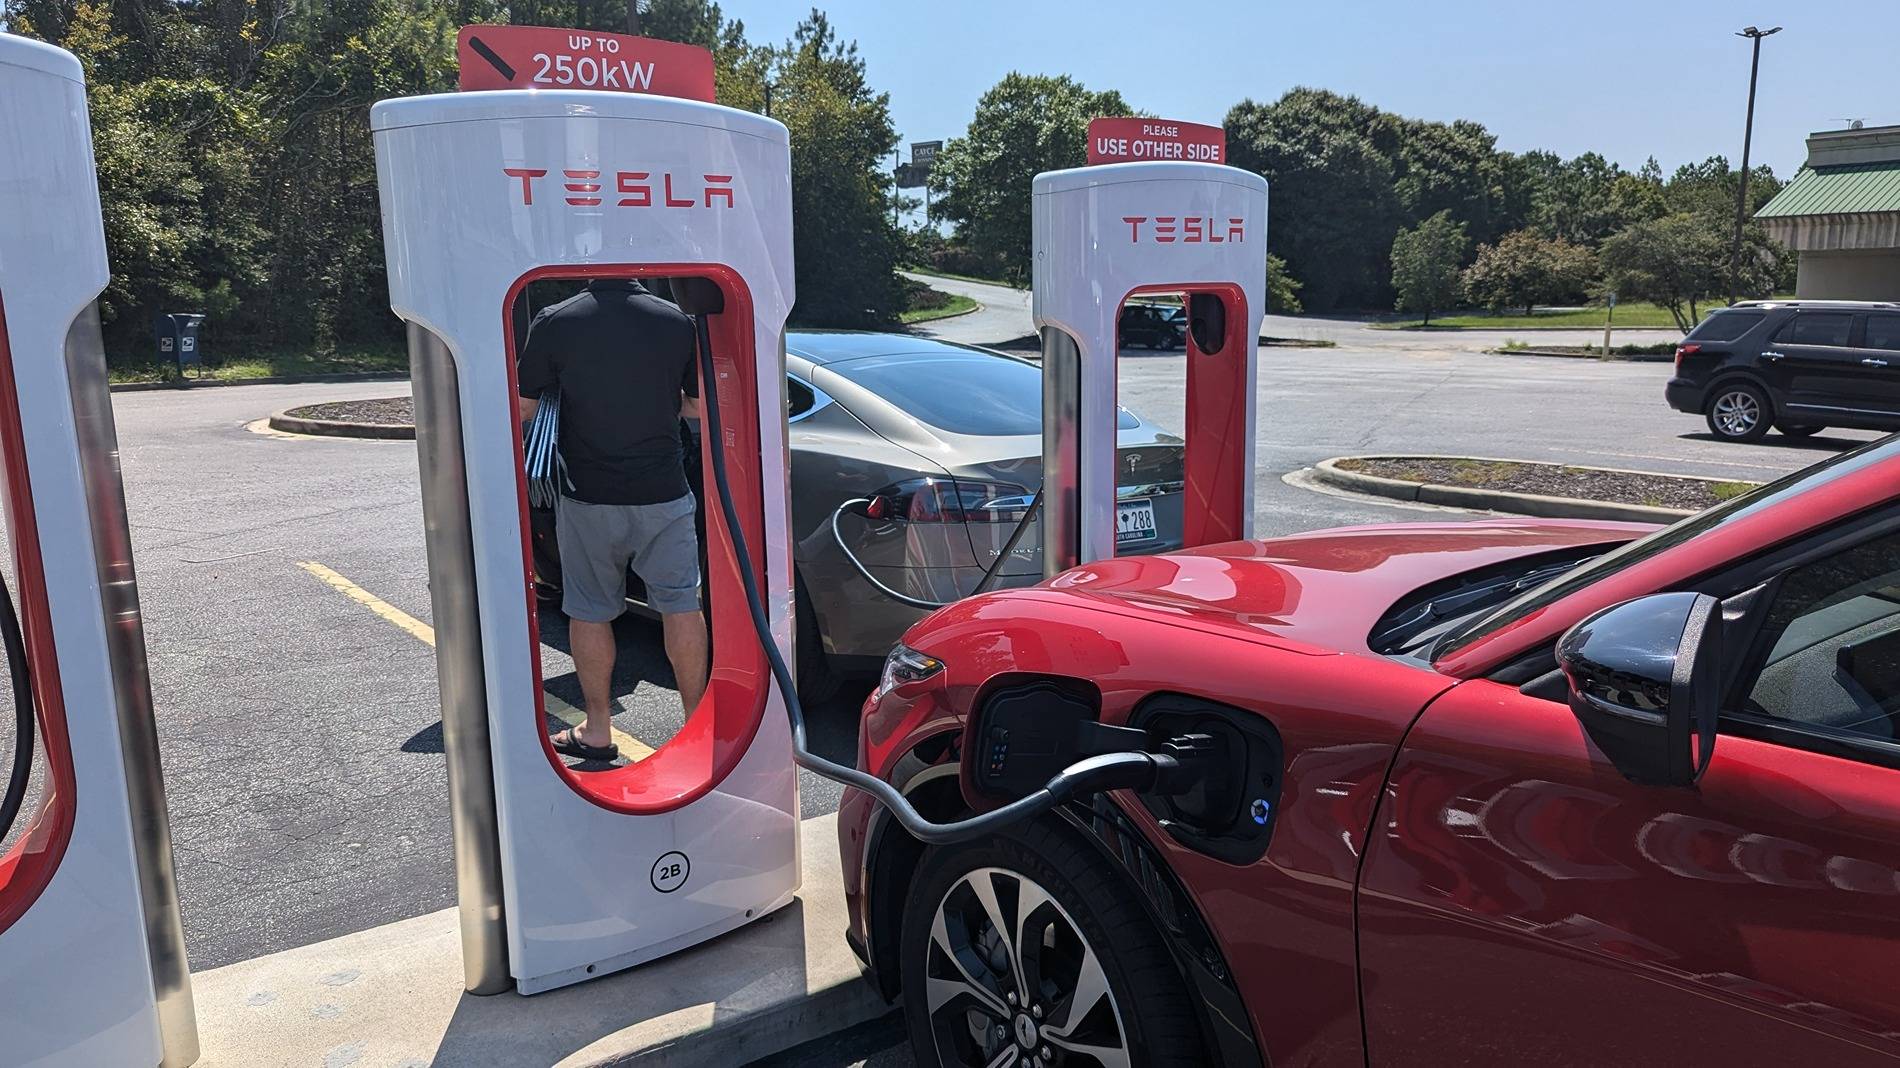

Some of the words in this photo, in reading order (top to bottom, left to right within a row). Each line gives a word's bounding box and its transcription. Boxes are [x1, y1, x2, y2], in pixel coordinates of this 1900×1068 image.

[568, 36, 591, 51] UP
[596, 38, 620, 54] TO
[532, 53, 655, 90] 250kW
[1143, 124, 1178, 137] PLEASE
[1097, 138, 1128, 156] USE
[1132, 140, 1183, 159] OTHER
[1187, 143, 1220, 161] SIDE
[503, 168, 733, 209] TESLA
[1122, 217, 1244, 243] TESLA
[1131, 510, 1152, 530] 288
[989, 548, 1034, 556] MDEL
[660, 863, 681, 880] 2B
